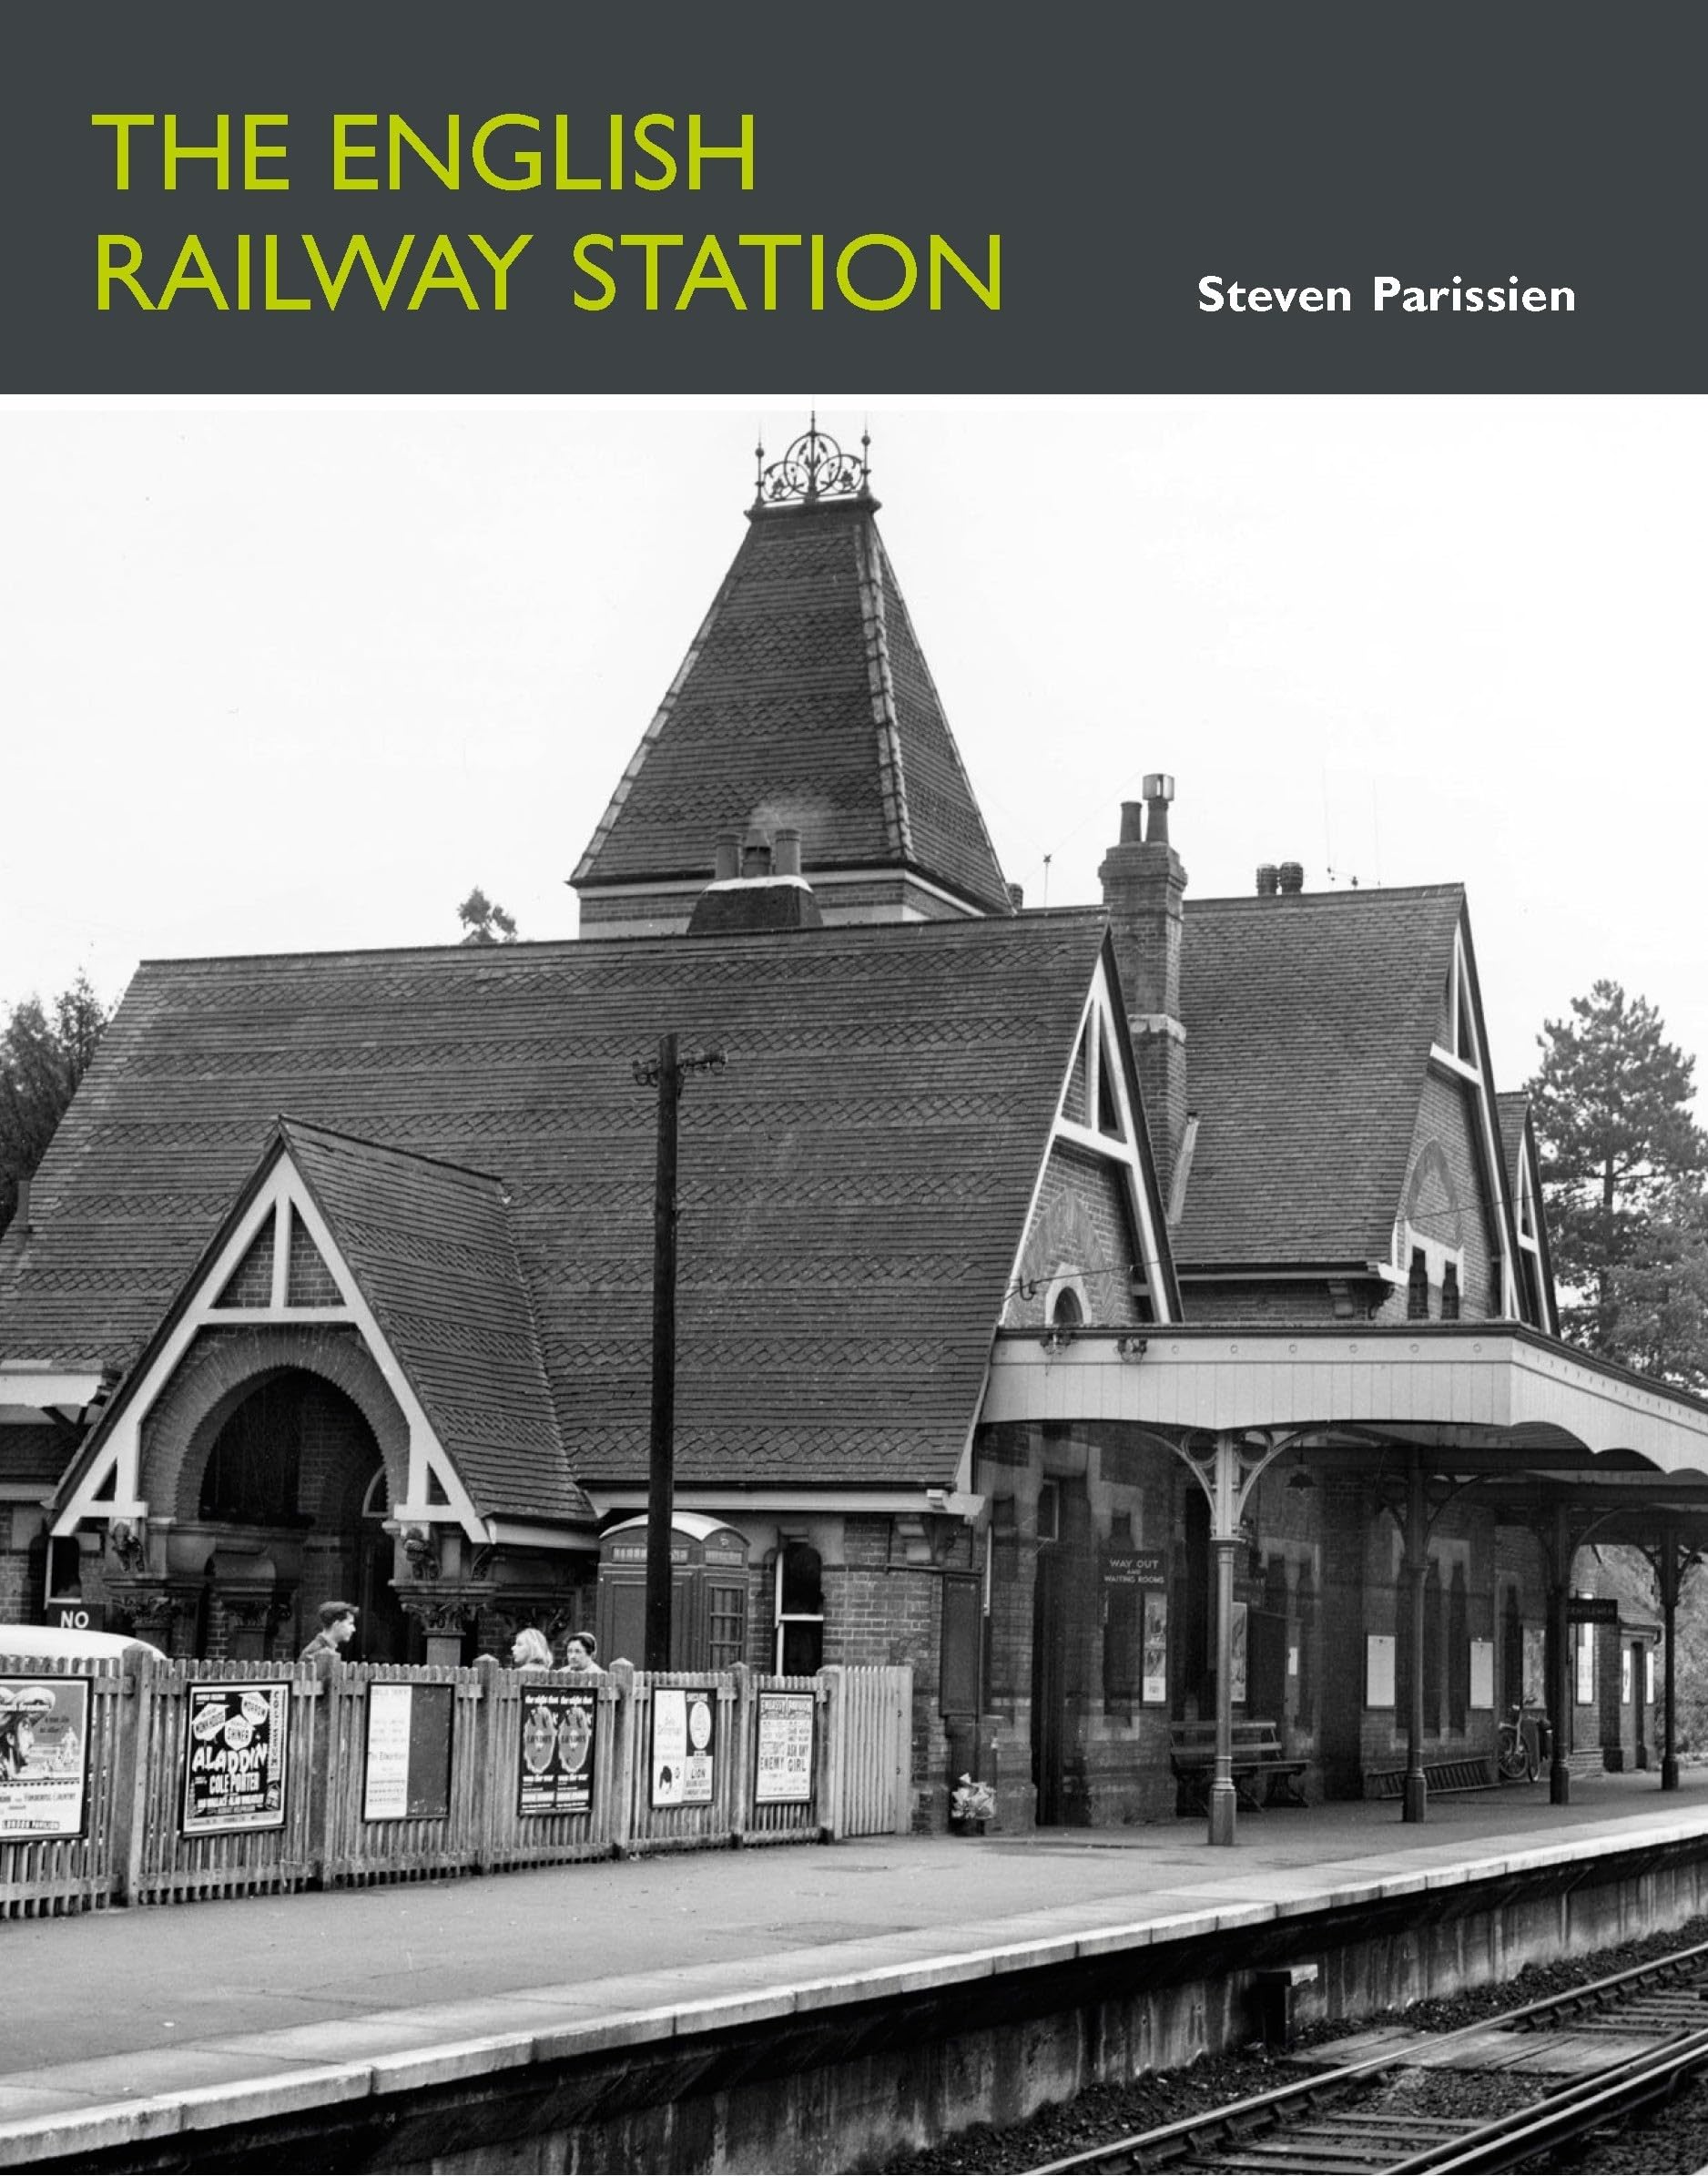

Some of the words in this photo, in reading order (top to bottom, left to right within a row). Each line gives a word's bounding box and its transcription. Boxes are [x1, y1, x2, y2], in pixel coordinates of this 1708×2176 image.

[1110, 1559, 1133, 1568] WAY
[1136, 1559, 1158, 1570] OUT
[1104, 1575, 1135, 1583] WAITING
[1138, 1576, 1164, 1584] ROOMS
[60, 1610, 89, 1629] NO
[192, 1742, 268, 1776] ALADDIN
[788, 1757, 807, 1773] GIRL
